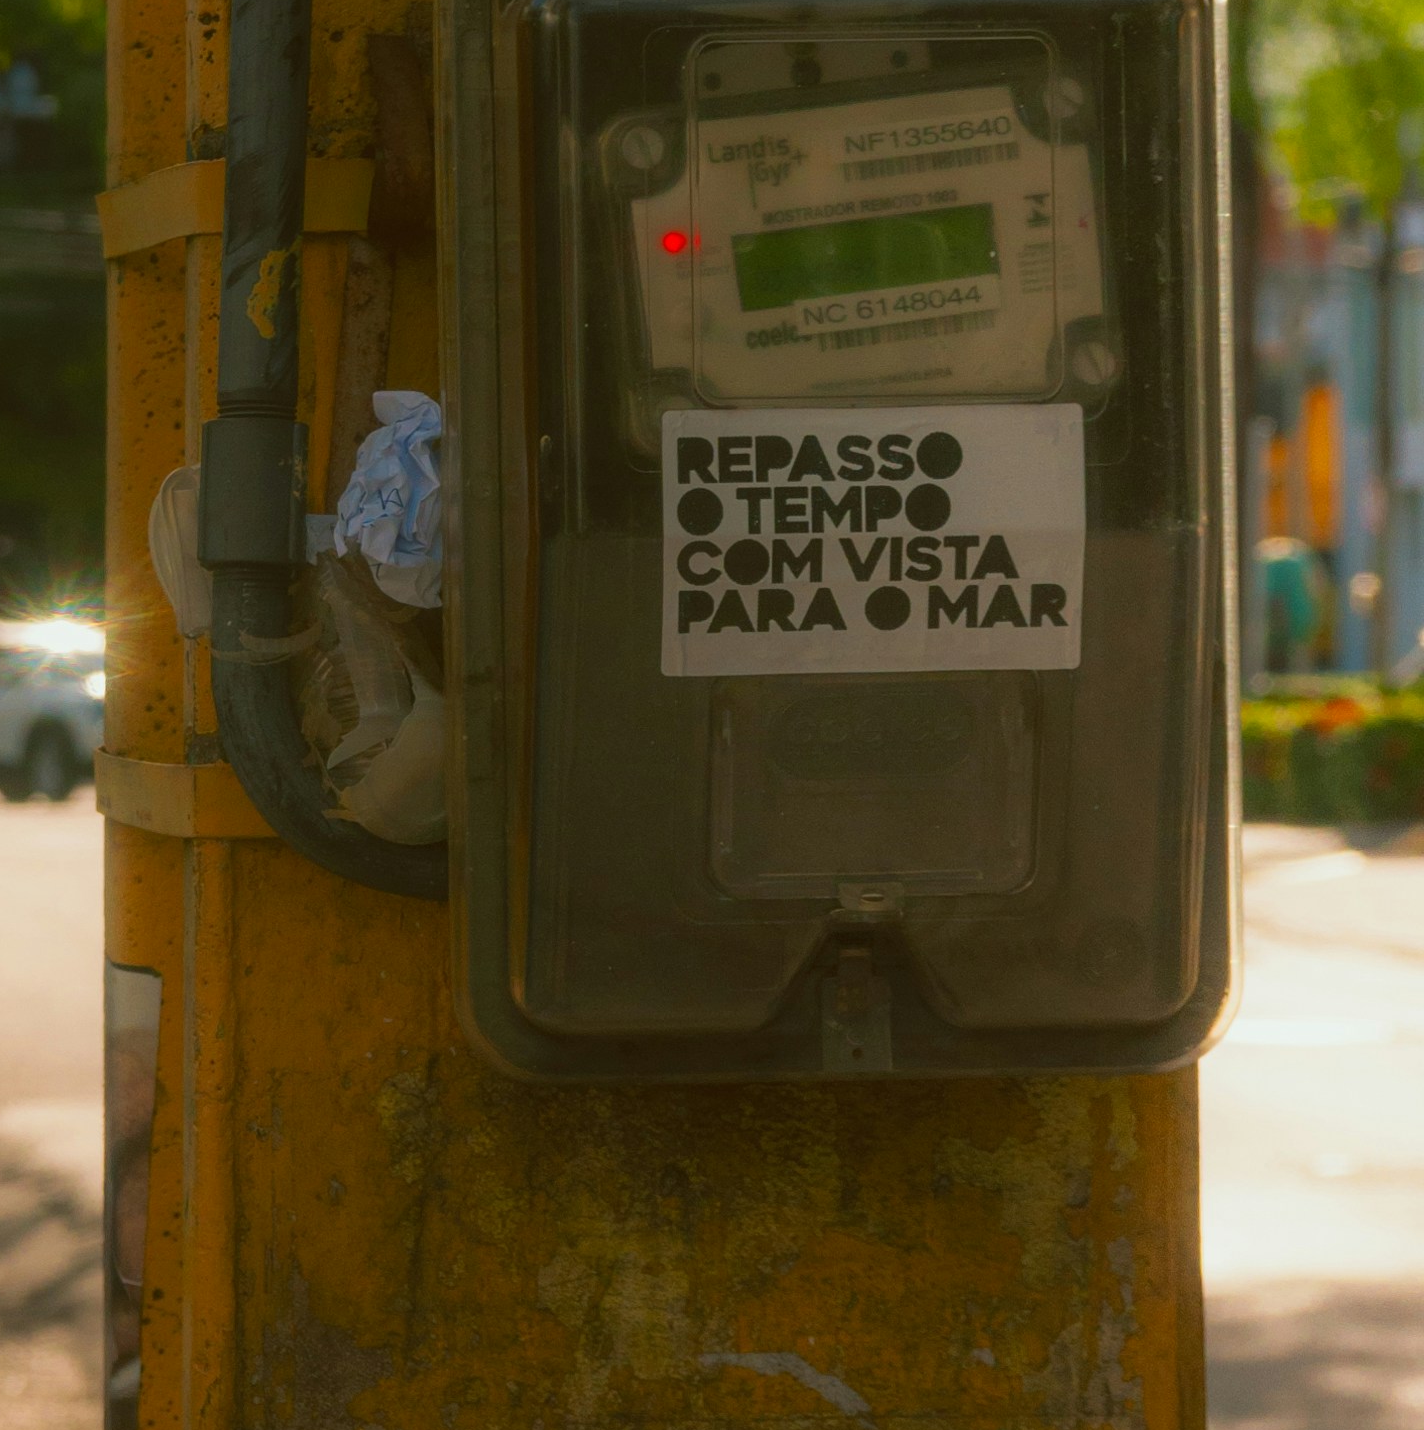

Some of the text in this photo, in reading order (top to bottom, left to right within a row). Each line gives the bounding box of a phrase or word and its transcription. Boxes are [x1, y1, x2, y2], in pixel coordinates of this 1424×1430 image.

[705, 134, 790, 164] Landis
[844, 116, 1012, 153] NF1355640
[761, 202, 856, 226] MOSTRADOR
[803, 285, 982, 326] NC 6148044
[676, 431, 964, 484] REPASSO
[677, 483, 952, 536] O TEMPO
[677, 534, 1020, 586] COM VISTA
[677, 582, 1070, 634] PARA O MAR
